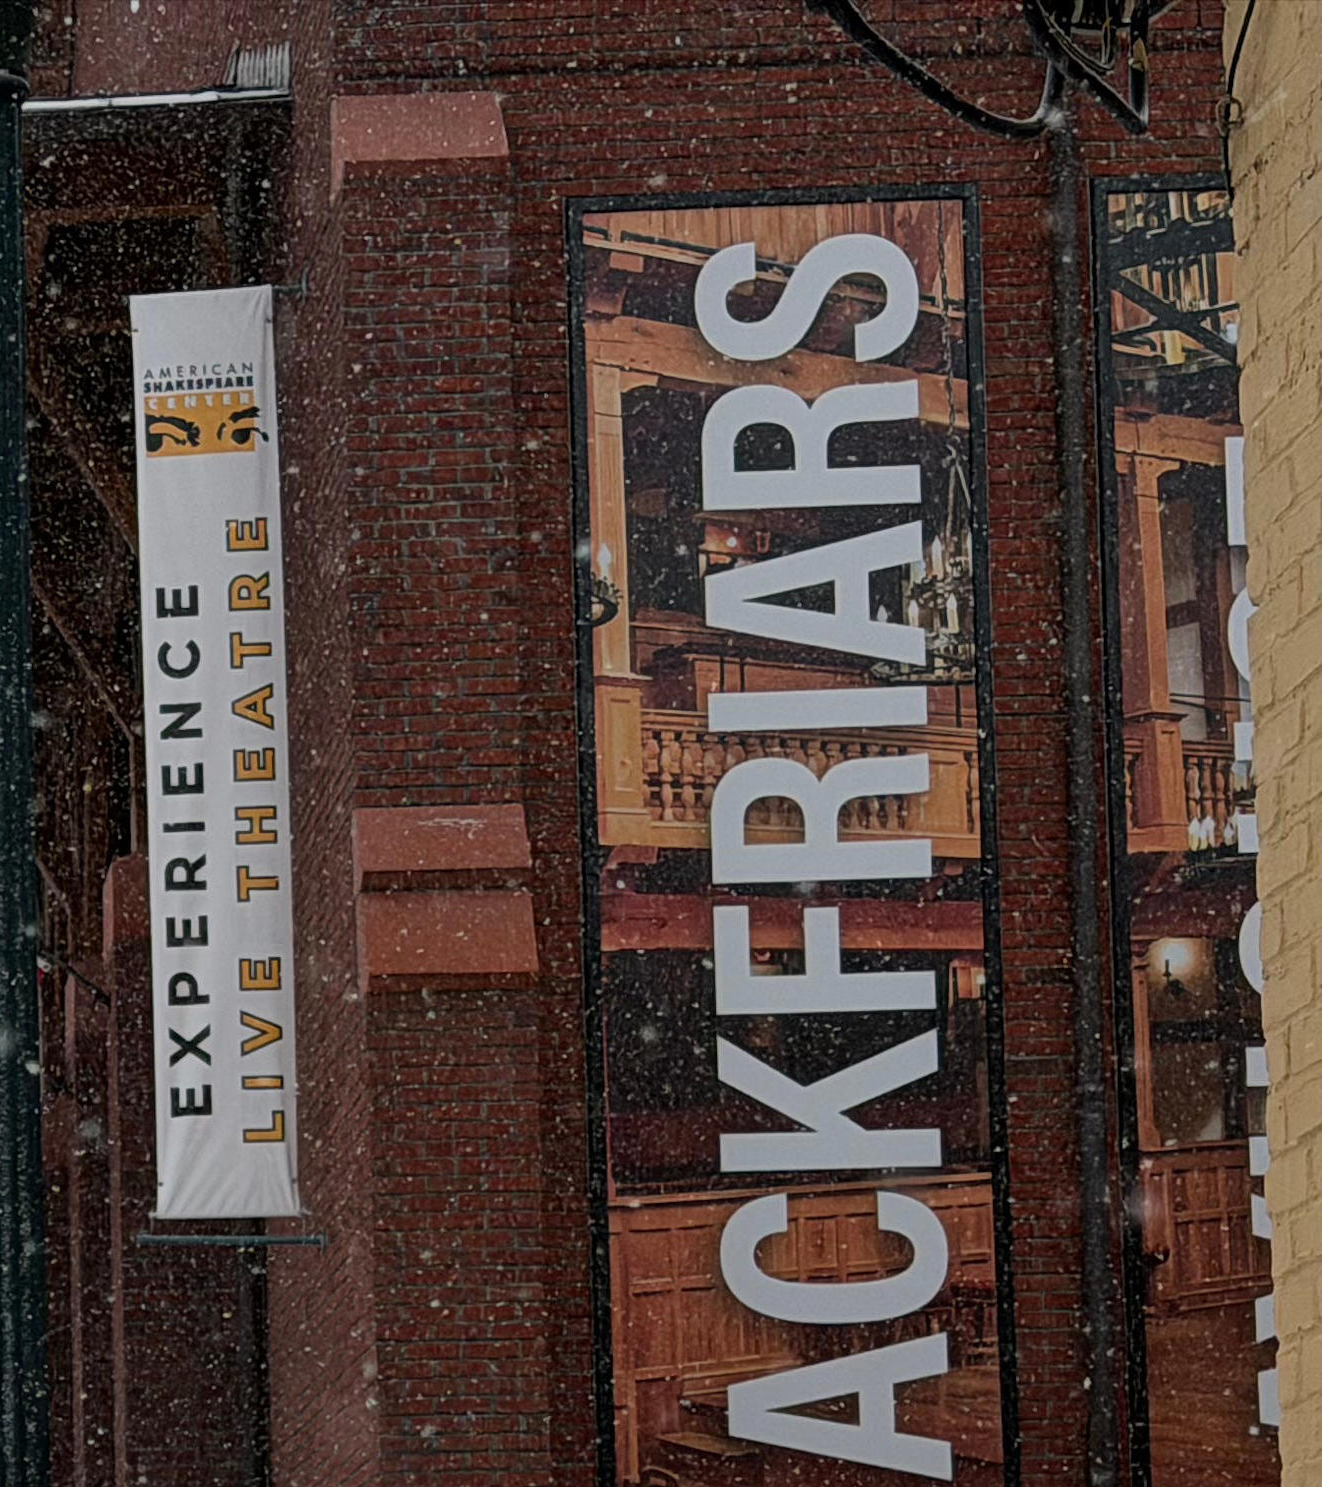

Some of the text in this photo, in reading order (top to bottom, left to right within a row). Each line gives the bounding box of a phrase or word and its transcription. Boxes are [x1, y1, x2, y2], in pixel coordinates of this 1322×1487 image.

[144, 361, 254, 380] AMERICAN
[143, 375, 254, 393] SHAKESPEARE
[148, 391, 251, 410] CENTER
[225, 516, 286, 1144] LIVE THEATRE
[155, 585, 213, 1118] EXPERIENCE
